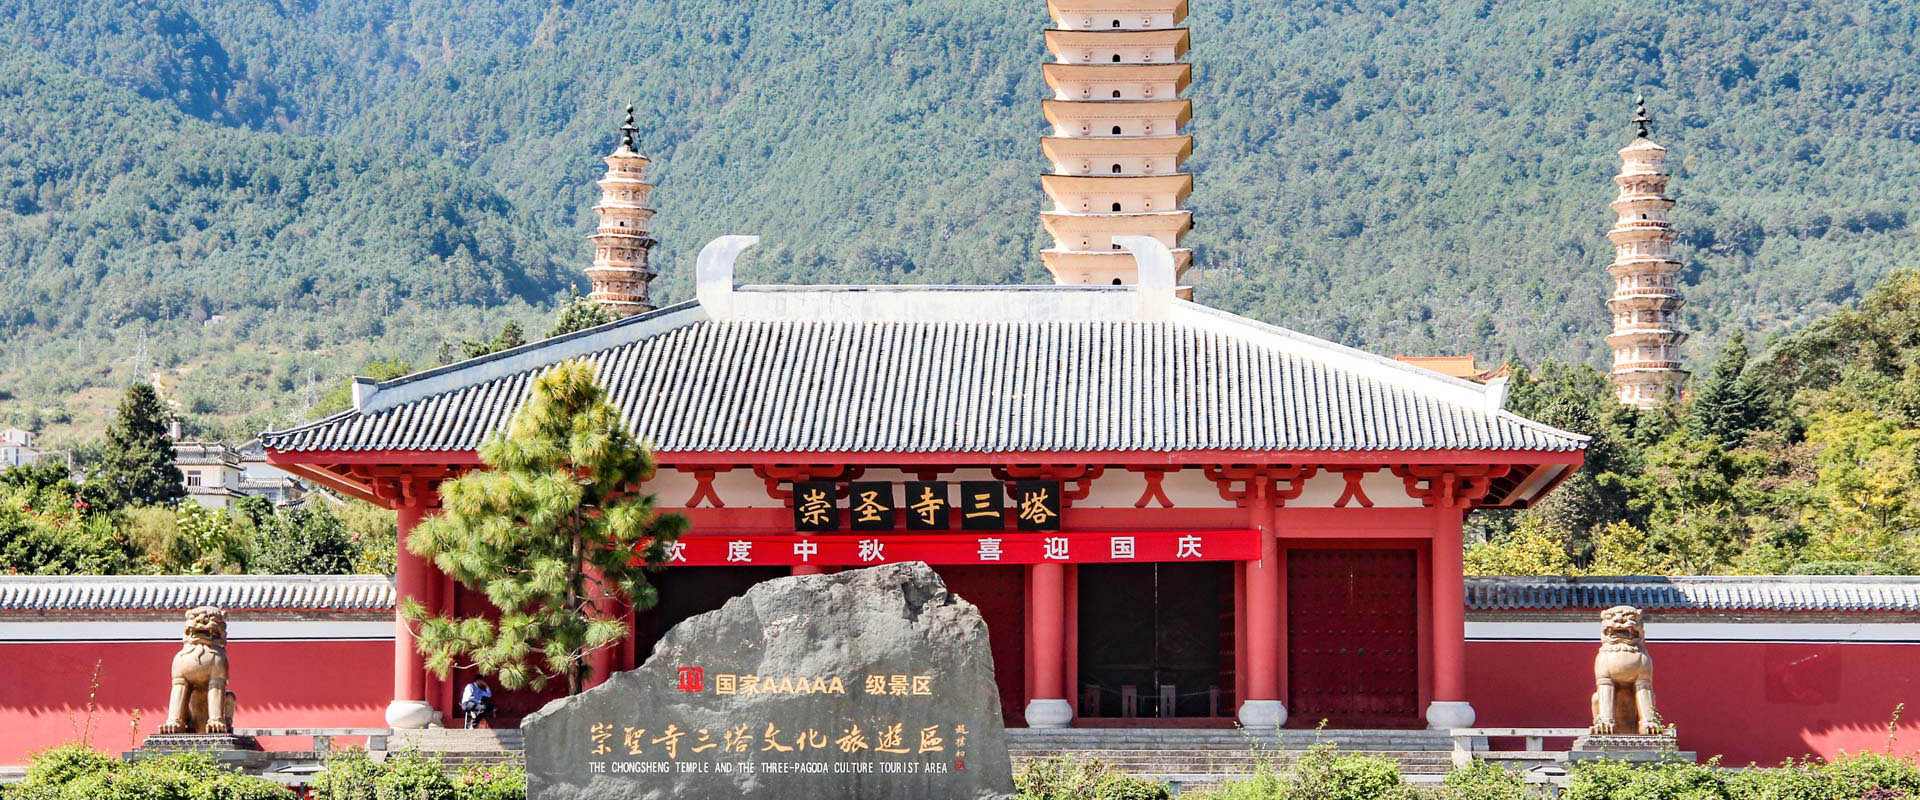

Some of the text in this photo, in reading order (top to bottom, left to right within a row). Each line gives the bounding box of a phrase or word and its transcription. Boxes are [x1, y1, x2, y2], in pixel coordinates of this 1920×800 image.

[799, 486, 1058, 526] 崇圣寺三塔
[662, 535, 1203, 564] 欢度中秋 喜迎国庆
[715, 673, 933, 697] 国家AAAAA 级景区
[589, 761, 606, 774] THE
[611, 761, 670, 774] CHONGSHENG
[675, 761, 709, 774] TEMPLE
[714, 761, 733, 774] AND
[738, 761, 755, 774] THE
[761, 761, 829, 774] THREE-PAGODA
[834, 761, 874, 774] CULTURE
[879, 761, 920, 774] TOURIST
[924, 761, 948, 774] AREA
